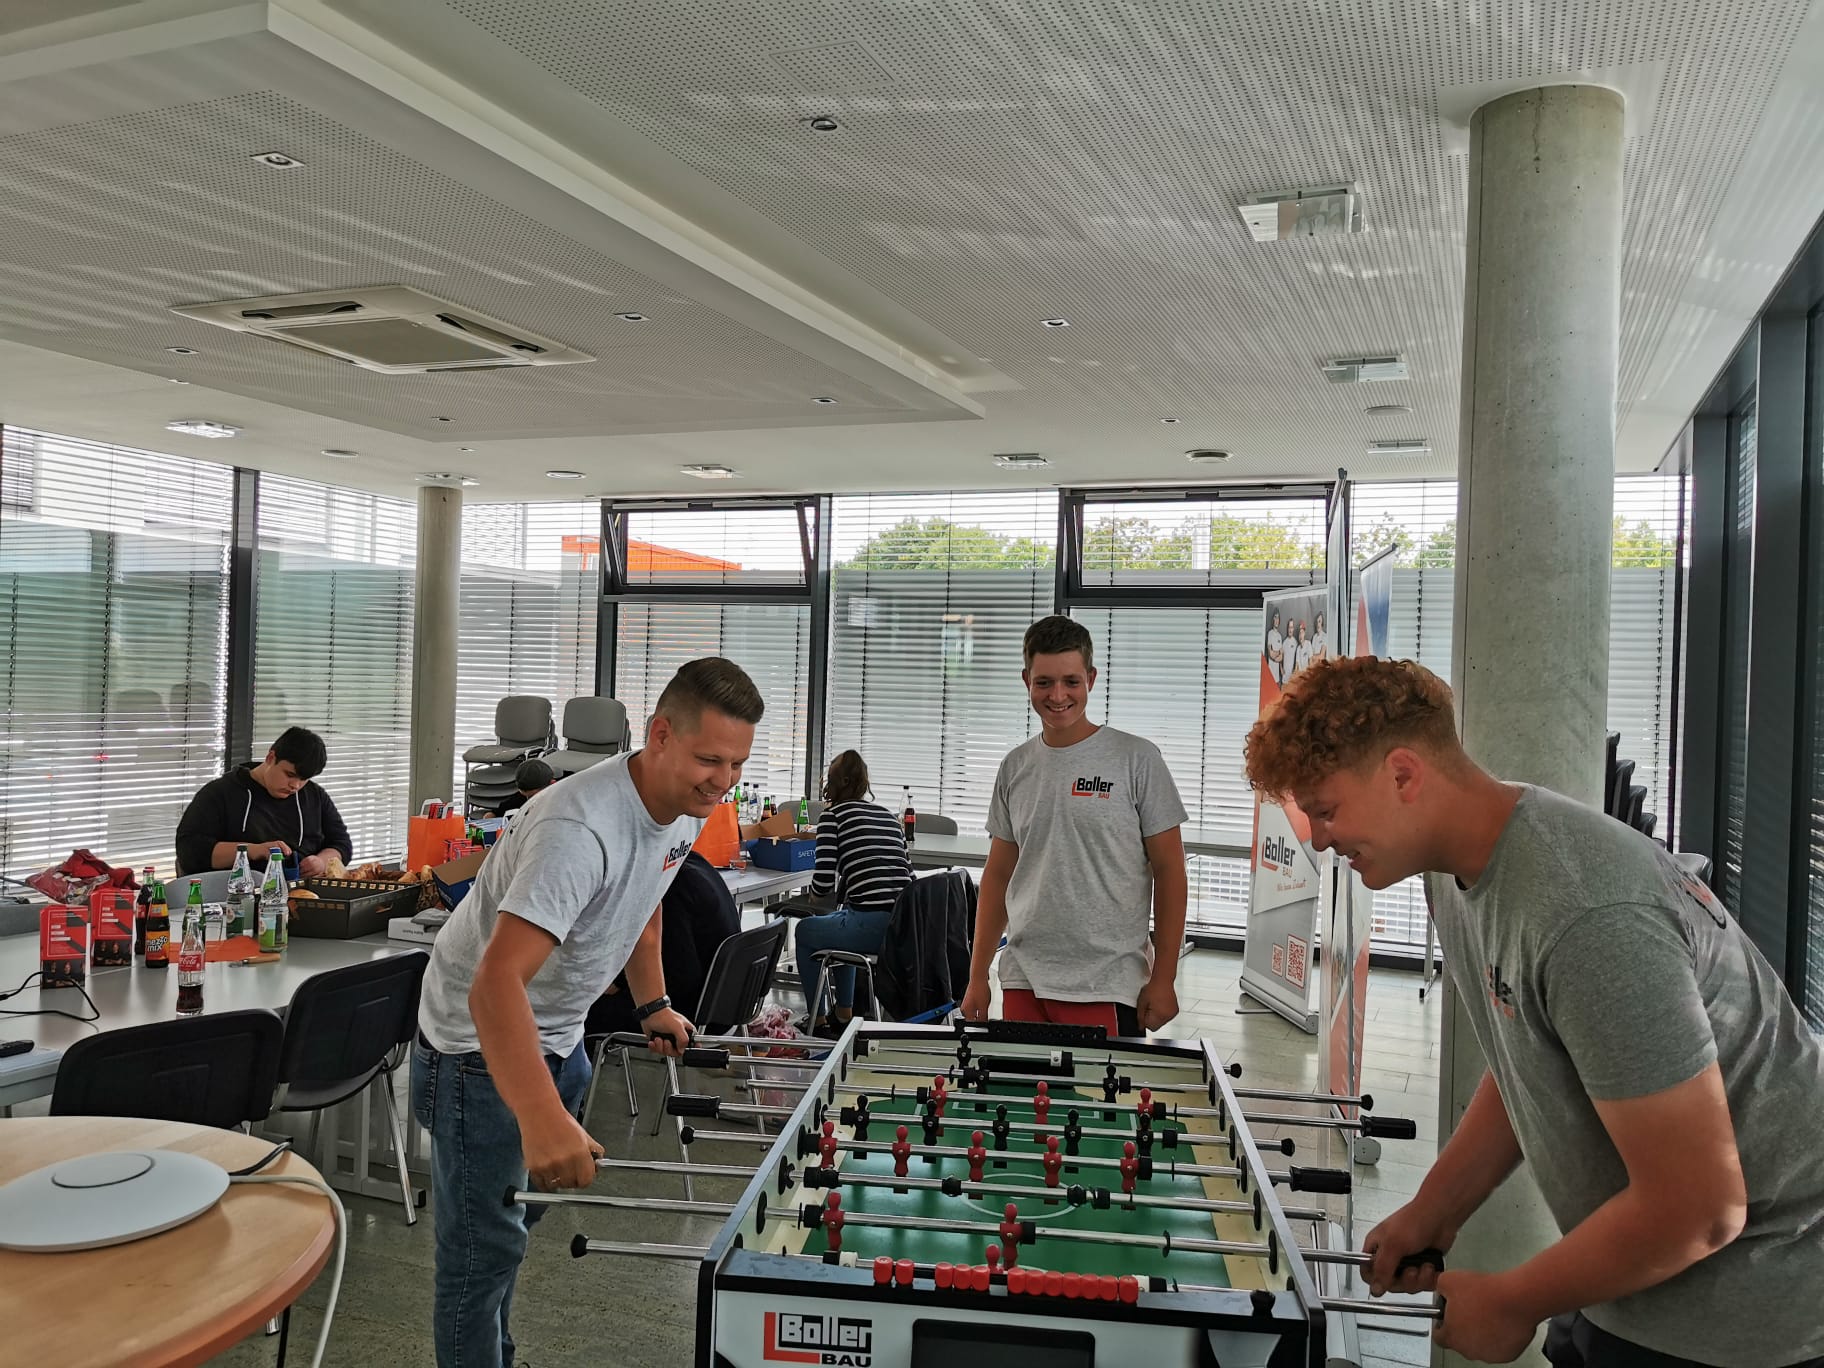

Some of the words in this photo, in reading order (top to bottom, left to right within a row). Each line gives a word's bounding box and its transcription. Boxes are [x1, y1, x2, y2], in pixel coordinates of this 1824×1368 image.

[1076, 776, 1114, 793] Boller
[1265, 835, 1296, 867] Boller
[148, 944, 163, 953] mix
[778, 1313, 872, 1347] Boller
[821, 1353, 871, 1368] BAU
